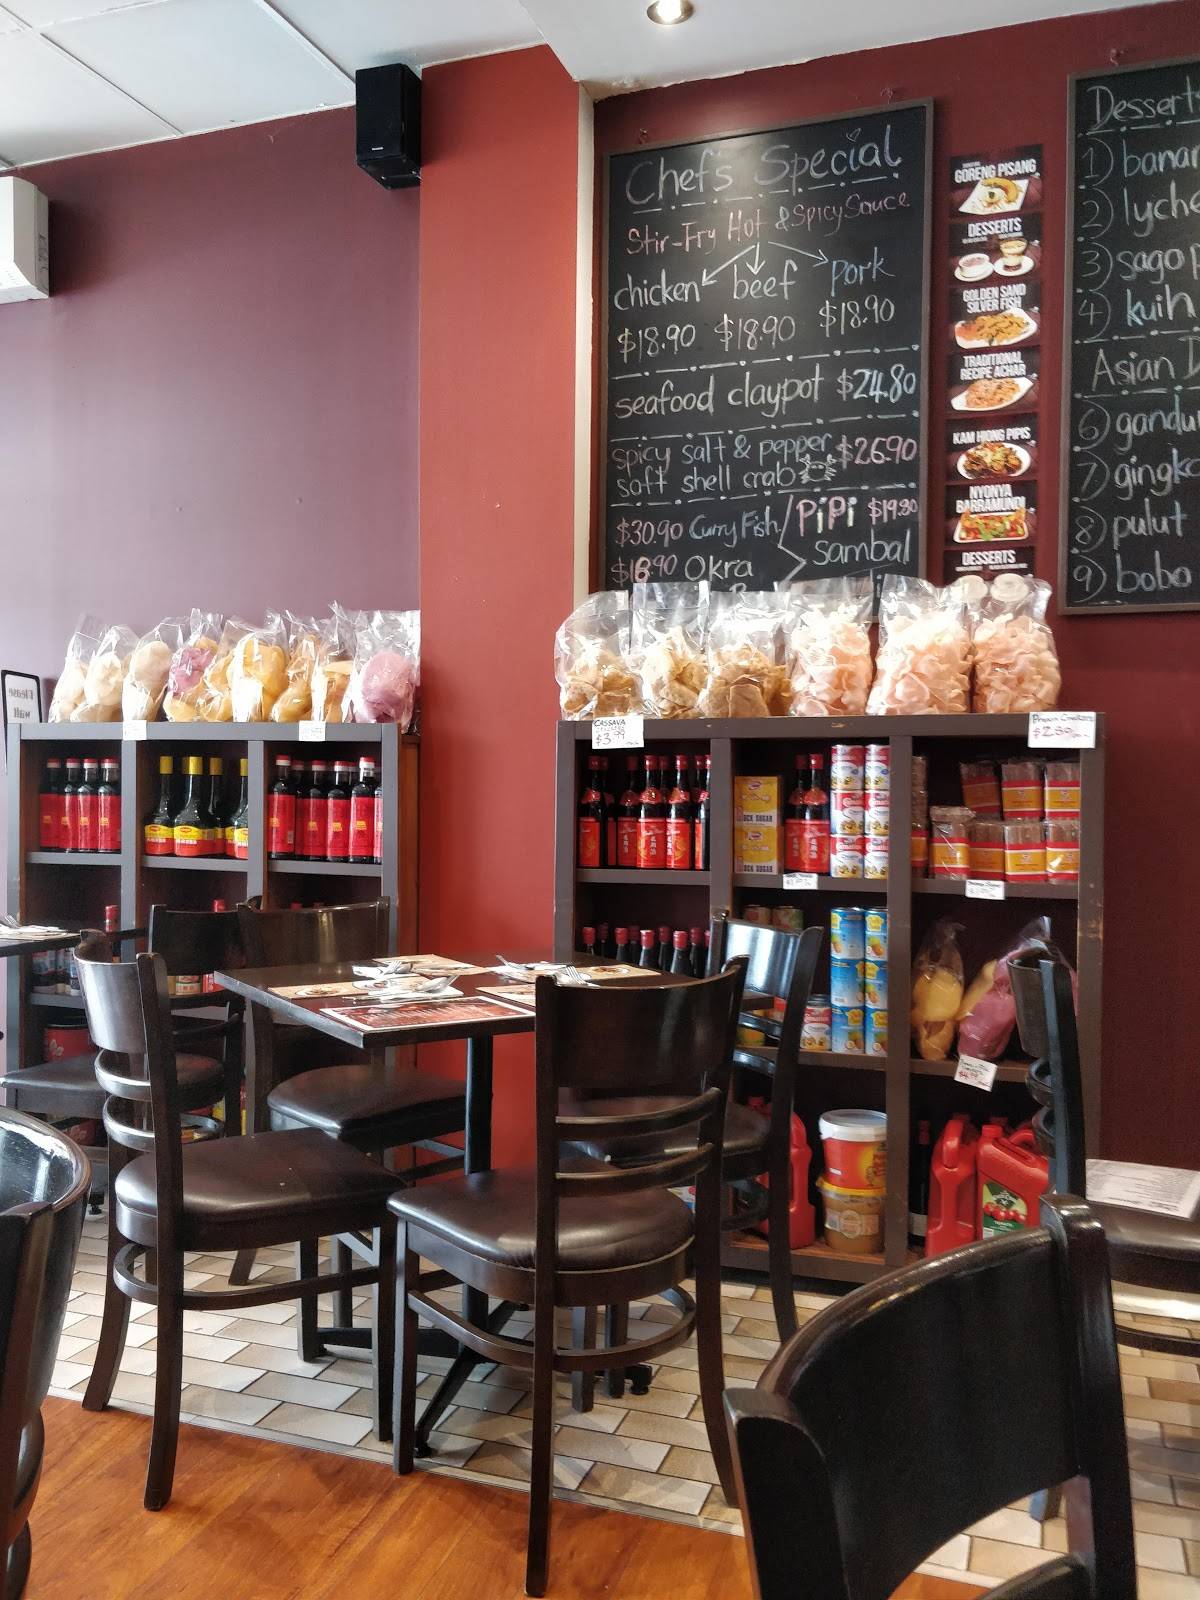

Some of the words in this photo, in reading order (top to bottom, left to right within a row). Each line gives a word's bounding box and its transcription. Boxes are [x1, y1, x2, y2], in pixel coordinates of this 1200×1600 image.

[754, 124, 902, 196] Special
[954, 163, 997, 184] GORENG
[997, 158, 1037, 179] PISANG
[626, 221, 716, 255] Stir-Fry
[727, 209, 768, 242] Hot
[844, 192, 910, 219] Sauce
[967, 217, 1023, 238] DESSERTS
[613, 268, 700, 311] chicken
[733, 258, 798, 300] beef
[831, 246, 895, 298] pork
[1116, 248, 1186, 284] sago
[962, 285, 999, 303] GOLDEN
[1000, 283, 1027, 300] SAND
[966, 299, 999, 314] SILVER
[1126, 283, 1197, 327] kuih
[617, 324, 696, 364] $18.90
[714, 313, 796, 352] $18.90
[819, 294, 895, 338] $18.90
[960, 365, 993, 381] RECIPE
[994, 363, 1027, 378] ACHAR
[963, 351, 1024, 368] TRADITIONAL
[1092, 348, 1176, 392] Asian
[614, 373, 715, 419] seafood
[727, 362, 824, 417] claypot
[953, 430, 976, 446] KAM
[1113, 394, 1200, 455] gandu
[611, 443, 671, 476] spicy
[681, 435, 726, 464] salt
[733, 434, 752, 458] &
[759, 433, 833, 467] pepper
[615, 465, 669, 498] soft
[681, 464, 731, 494] shell
[742, 461, 797, 489] crab
[615, 517, 684, 548] $30.90
[688, 514, 738, 549] Curry
[1112, 498, 1188, 551] pulut
[684, 555, 755, 582] Okra
[962, 549, 1017, 566] DESSERTS
[593, 719, 626, 727] CASSAVA
